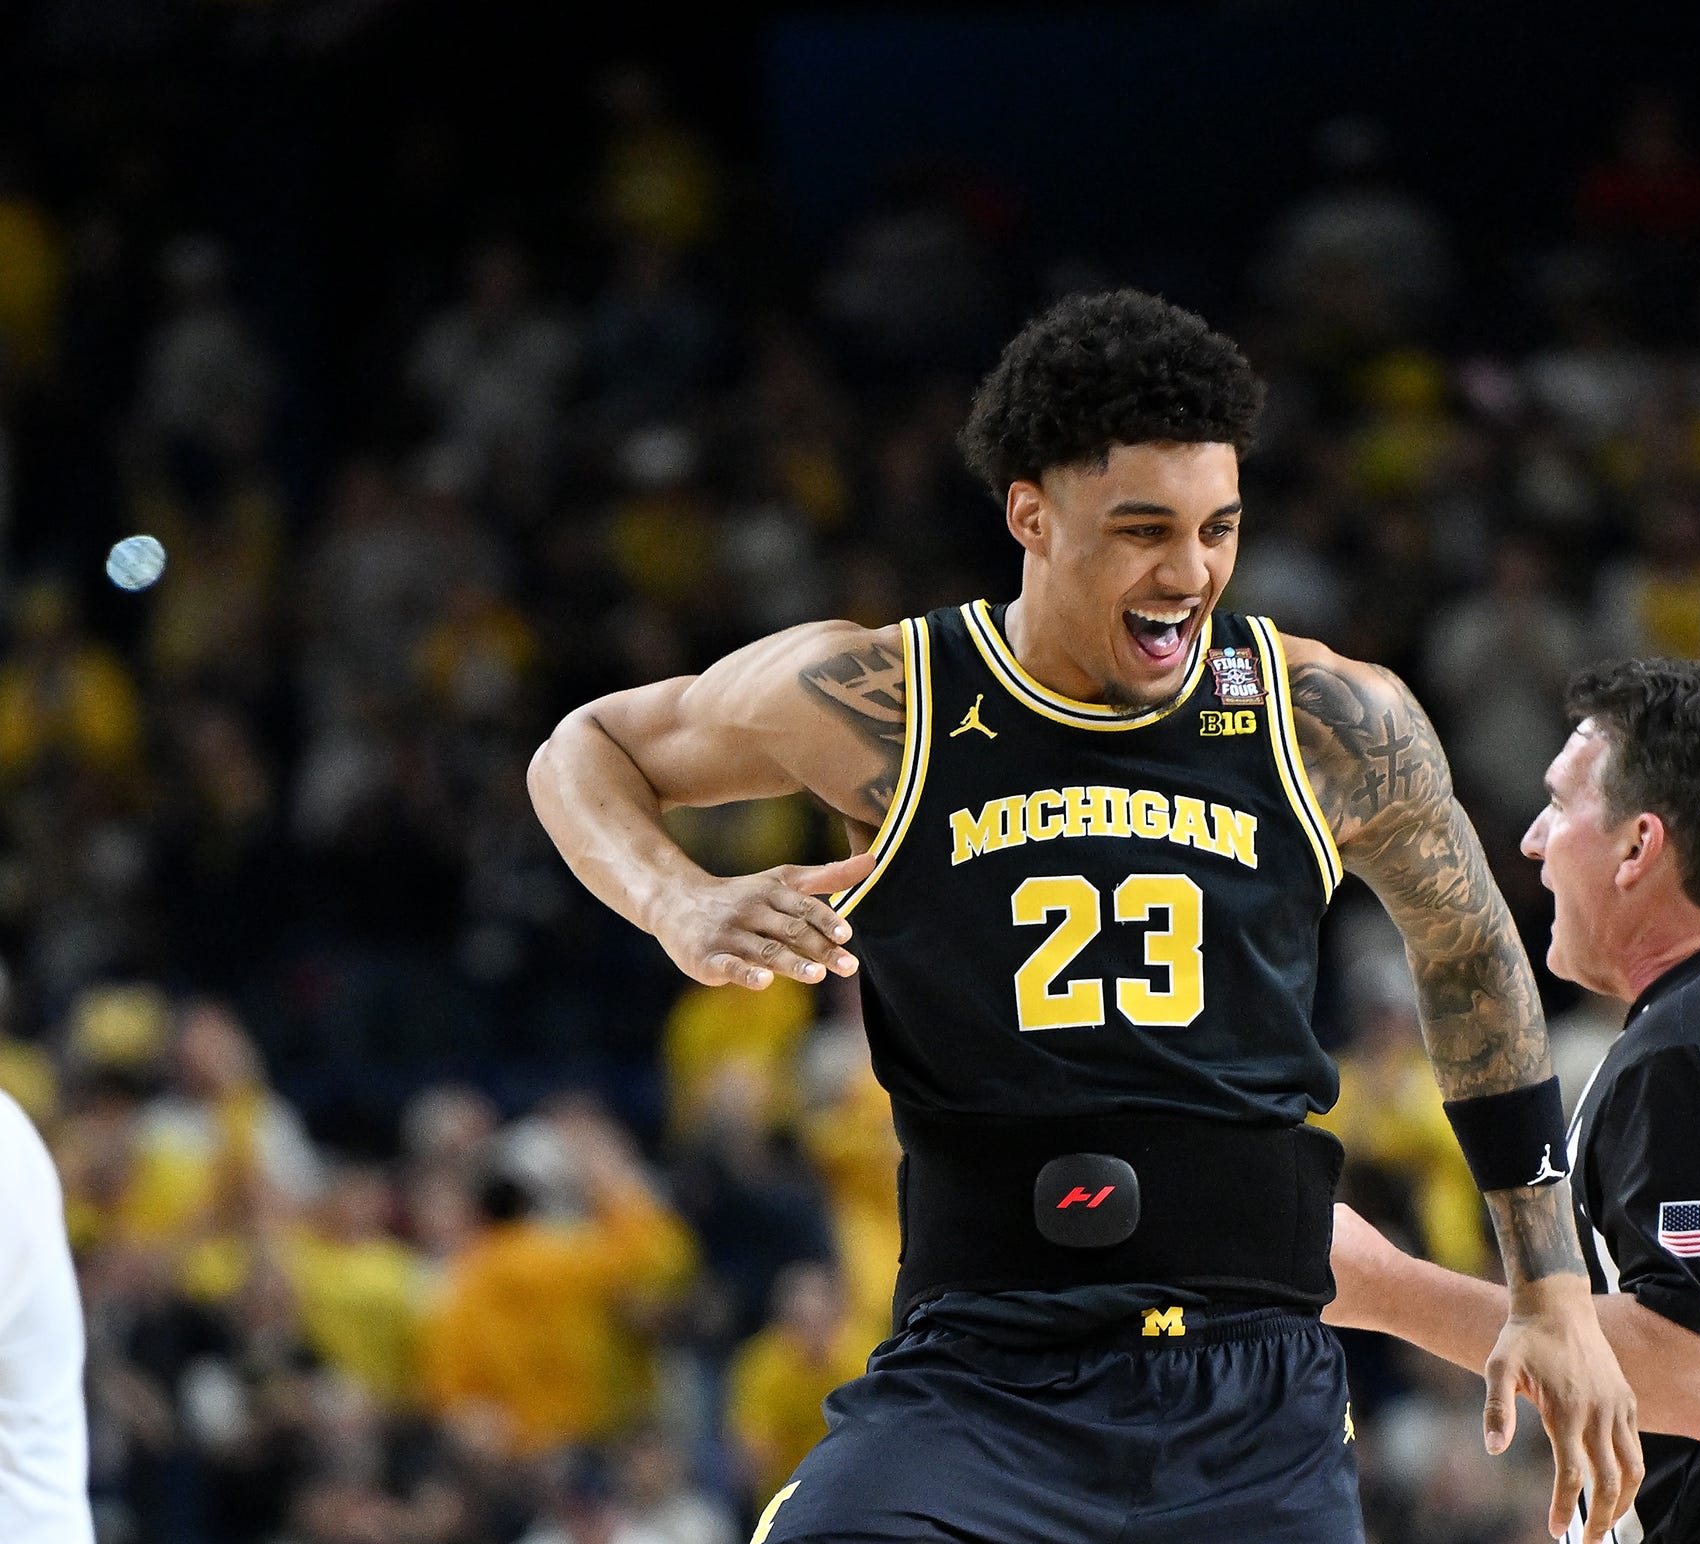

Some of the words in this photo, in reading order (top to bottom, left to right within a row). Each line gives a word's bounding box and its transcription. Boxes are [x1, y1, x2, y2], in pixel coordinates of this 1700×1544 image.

[1212, 657, 1252, 671] FINAL
[1221, 683, 1259, 697] FOUR
[949, 786, 1259, 870] MICHIGAN
[1010, 873, 1205, 1032] 23
[1140, 1306, 1187, 1337] M
